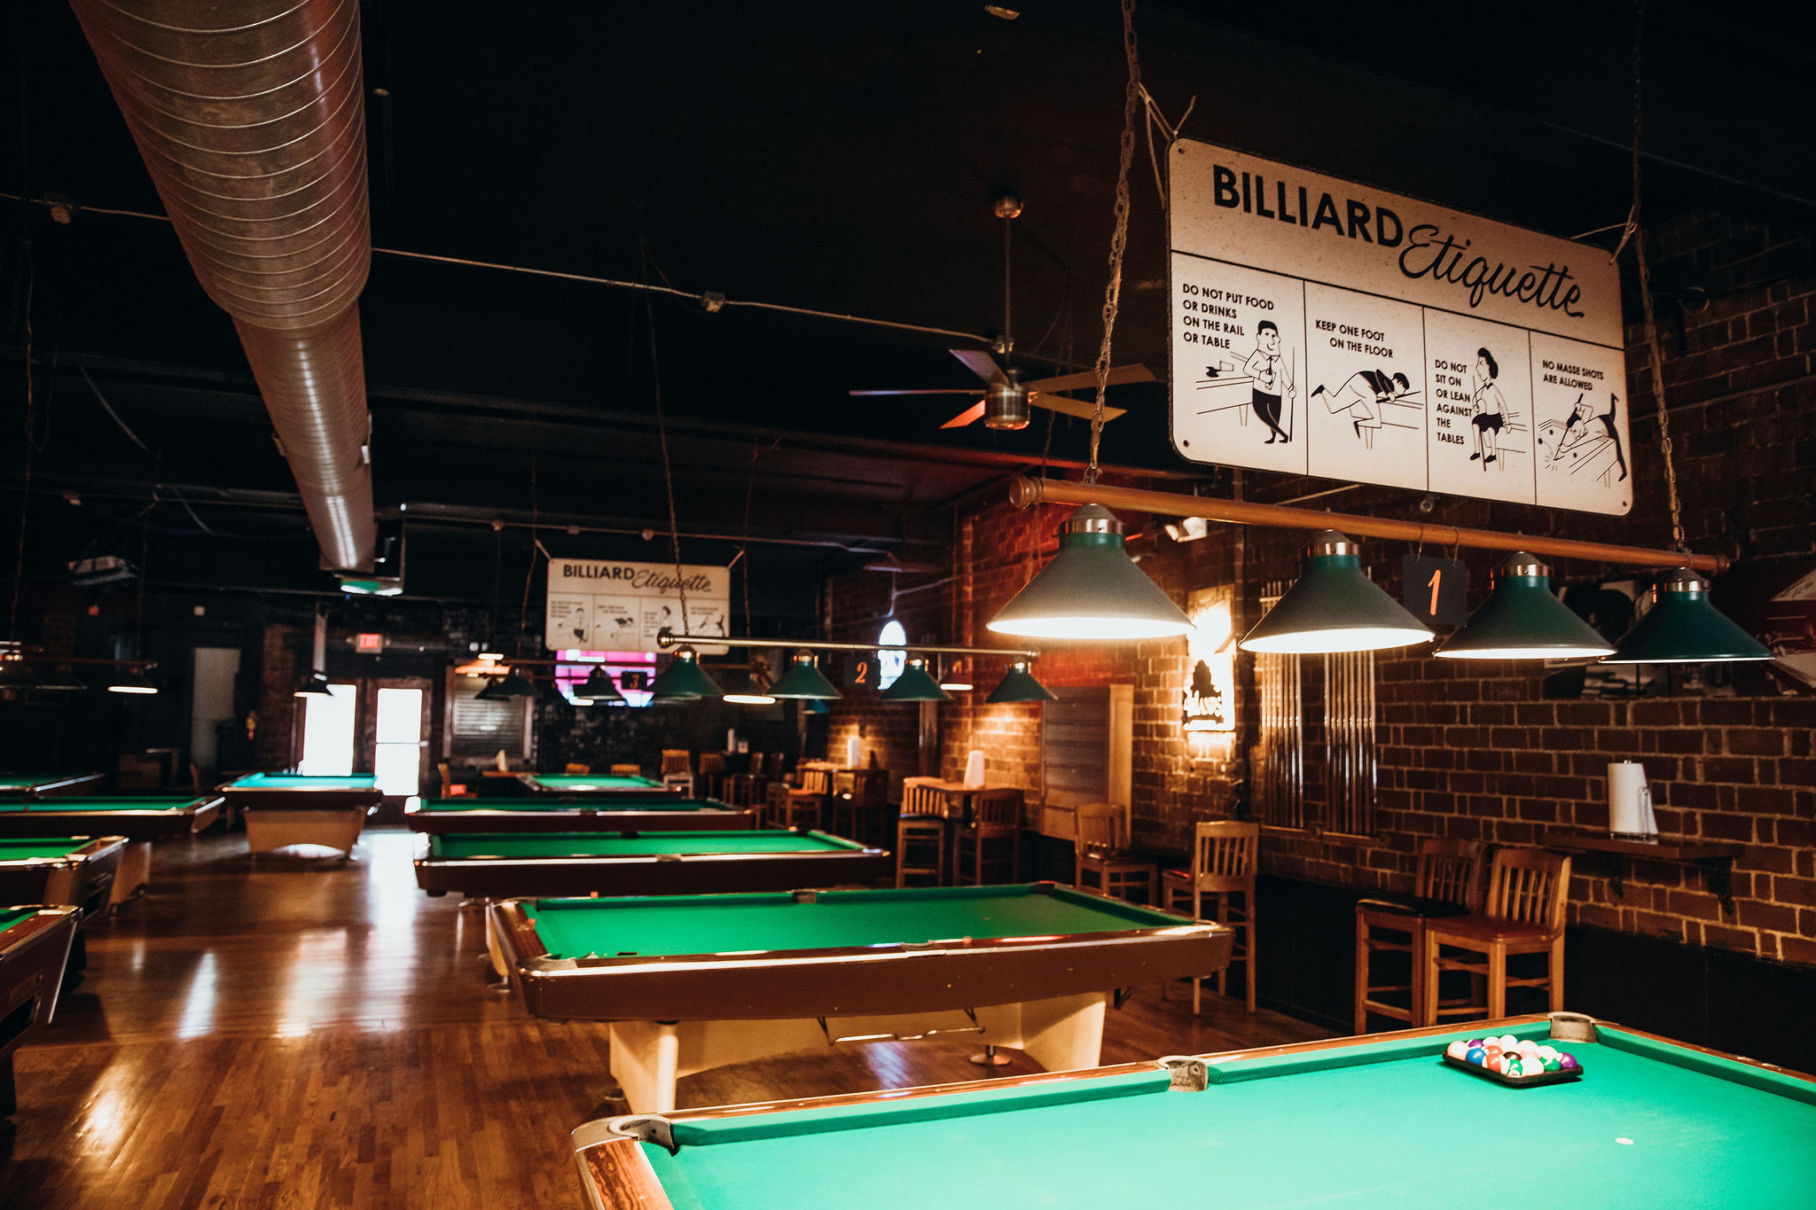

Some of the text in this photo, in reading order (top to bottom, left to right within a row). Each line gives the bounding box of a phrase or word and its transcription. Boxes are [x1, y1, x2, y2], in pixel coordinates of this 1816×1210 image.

[1213, 164, 1585, 318] BILLIARD Etiquette
[1183, 283, 1274, 310] DO NOT PUT FOOD
[1183, 300, 1237, 319] OR DRINKS
[1183, 315, 1245, 336] ON THE RAIL
[1315, 319, 1385, 342] KEEP ONE FOOT
[1183, 331, 1230, 349] OR TABLE
[1329, 337, 1393, 358] ON THE FLOOR
[1435, 359, 1467, 374] DO NOT
[1542, 359, 1604, 380] NO MASSE SHOTS
[1435, 373, 1461, 387] SIT ON
[1543, 374, 1593, 391] ARE ALLOWED
[1436, 388, 1470, 403] OR LEAN
[1436, 402, 1472, 417] AGAINST
[1436, 417, 1451, 428] THE
[1437, 432, 1464, 445] TABLES
[563, 564, 712, 595] BILLIARD Etiquette
[1428, 569, 1441, 616] 1
[629, 674, 640, 689] 3
[854, 661, 868, 684] 2
